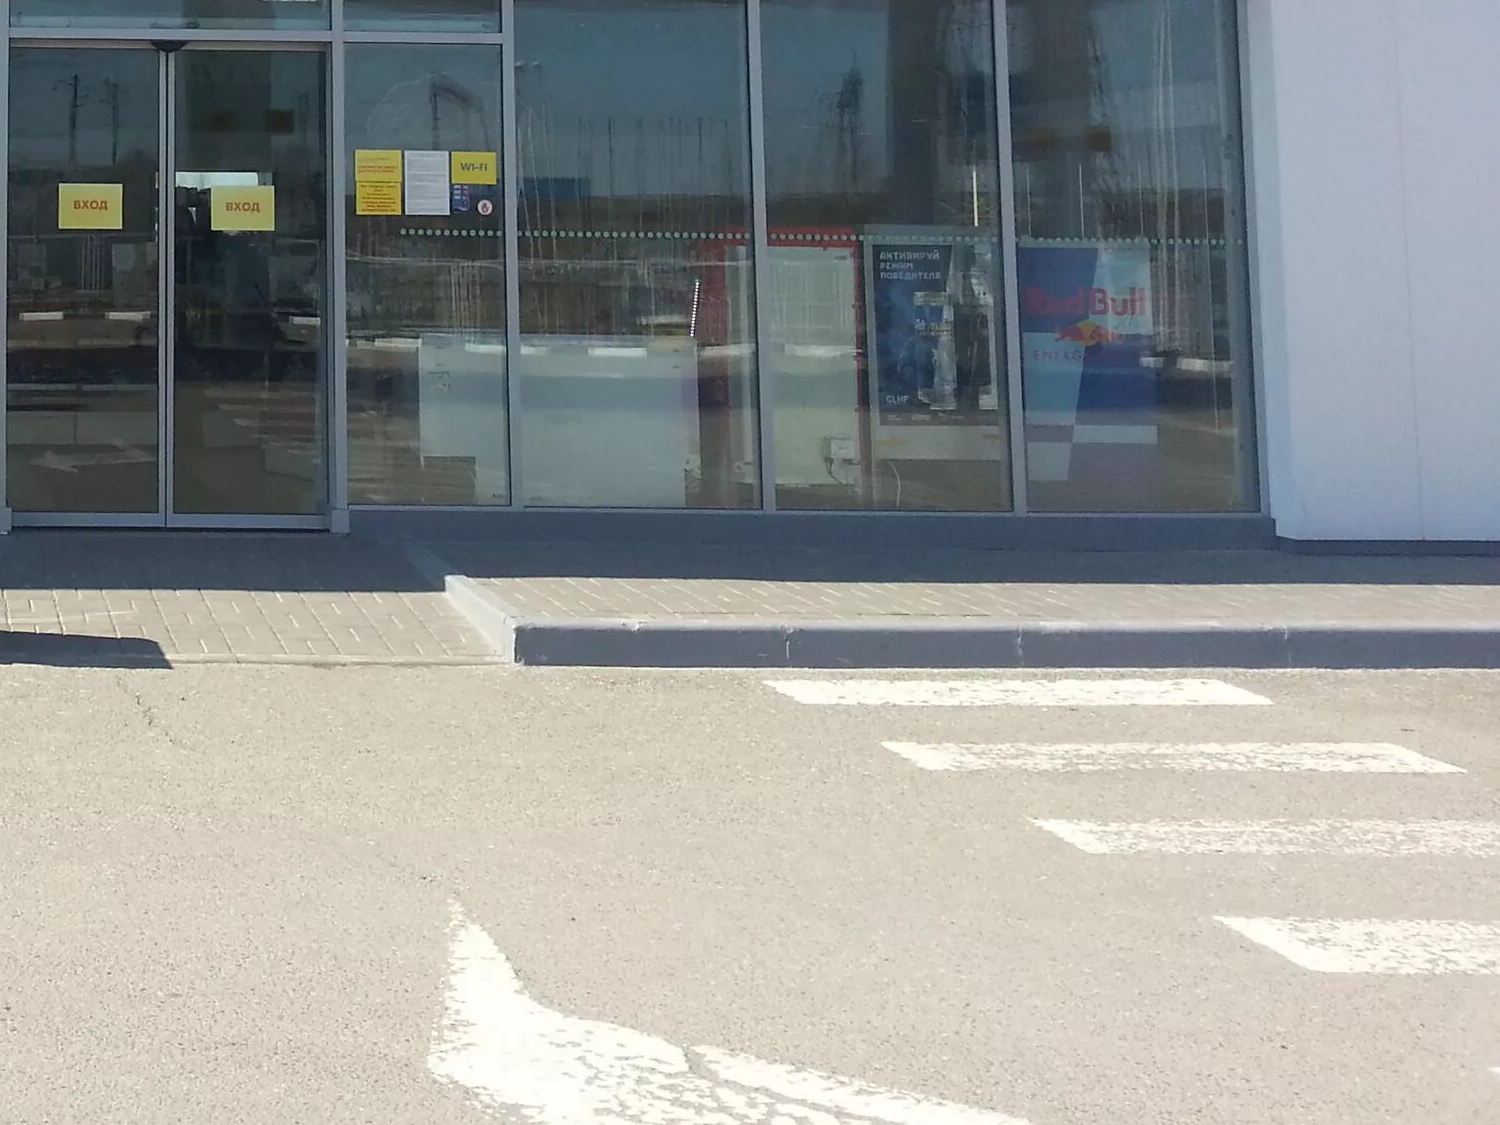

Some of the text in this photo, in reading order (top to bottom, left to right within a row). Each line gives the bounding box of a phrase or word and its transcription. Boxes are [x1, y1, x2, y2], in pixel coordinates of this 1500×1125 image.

[73, 199, 108, 211] ВХОД
[225, 201, 260, 213] ВХОД
[1025, 287, 1146, 316] Red Bull
